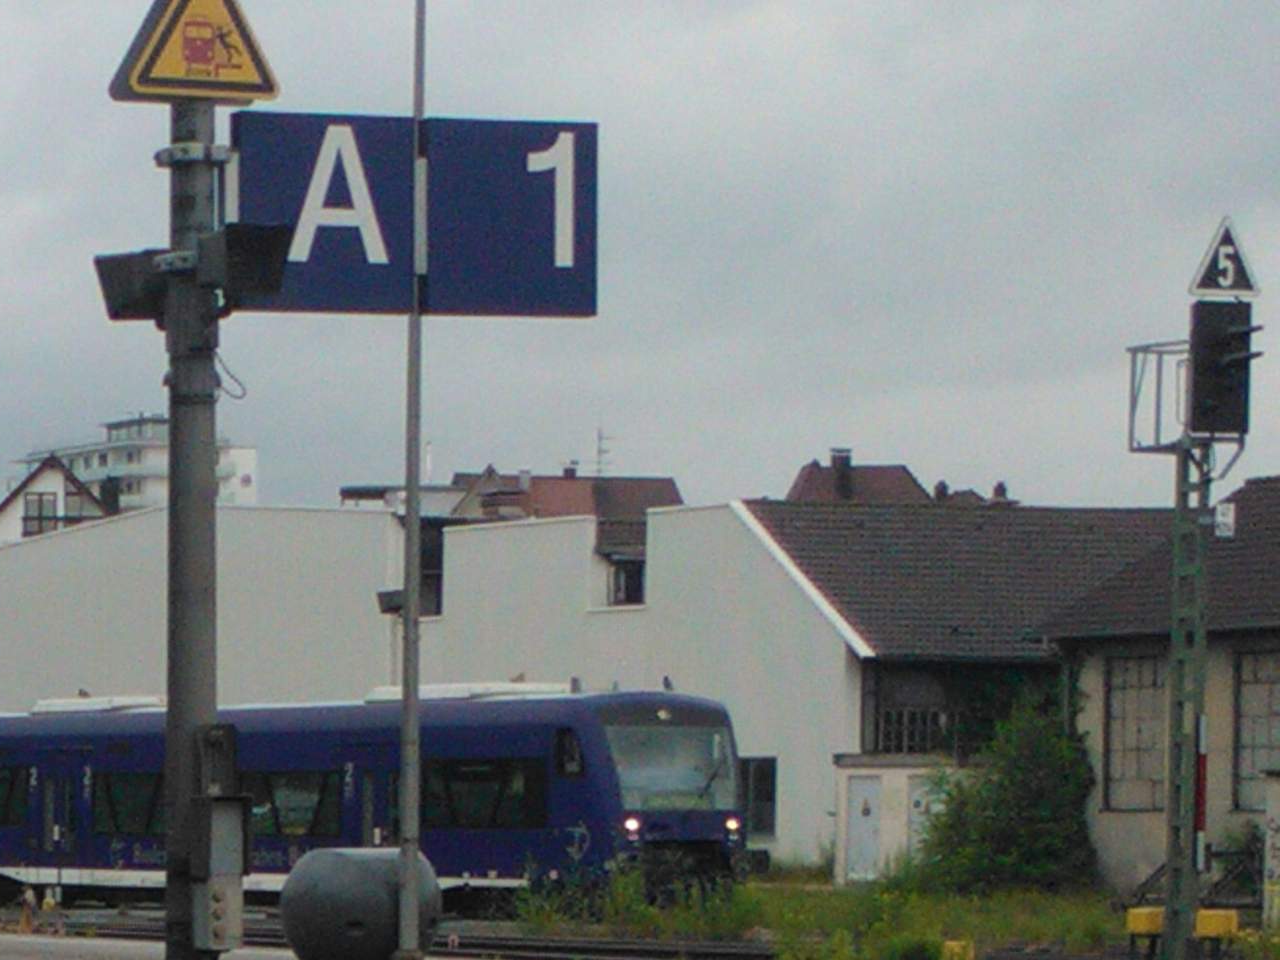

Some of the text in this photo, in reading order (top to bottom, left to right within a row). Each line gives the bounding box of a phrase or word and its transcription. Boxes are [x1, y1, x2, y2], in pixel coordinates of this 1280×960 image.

[287, 124, 575, 268] A 1
[1218, 245, 1234, 288] 5
